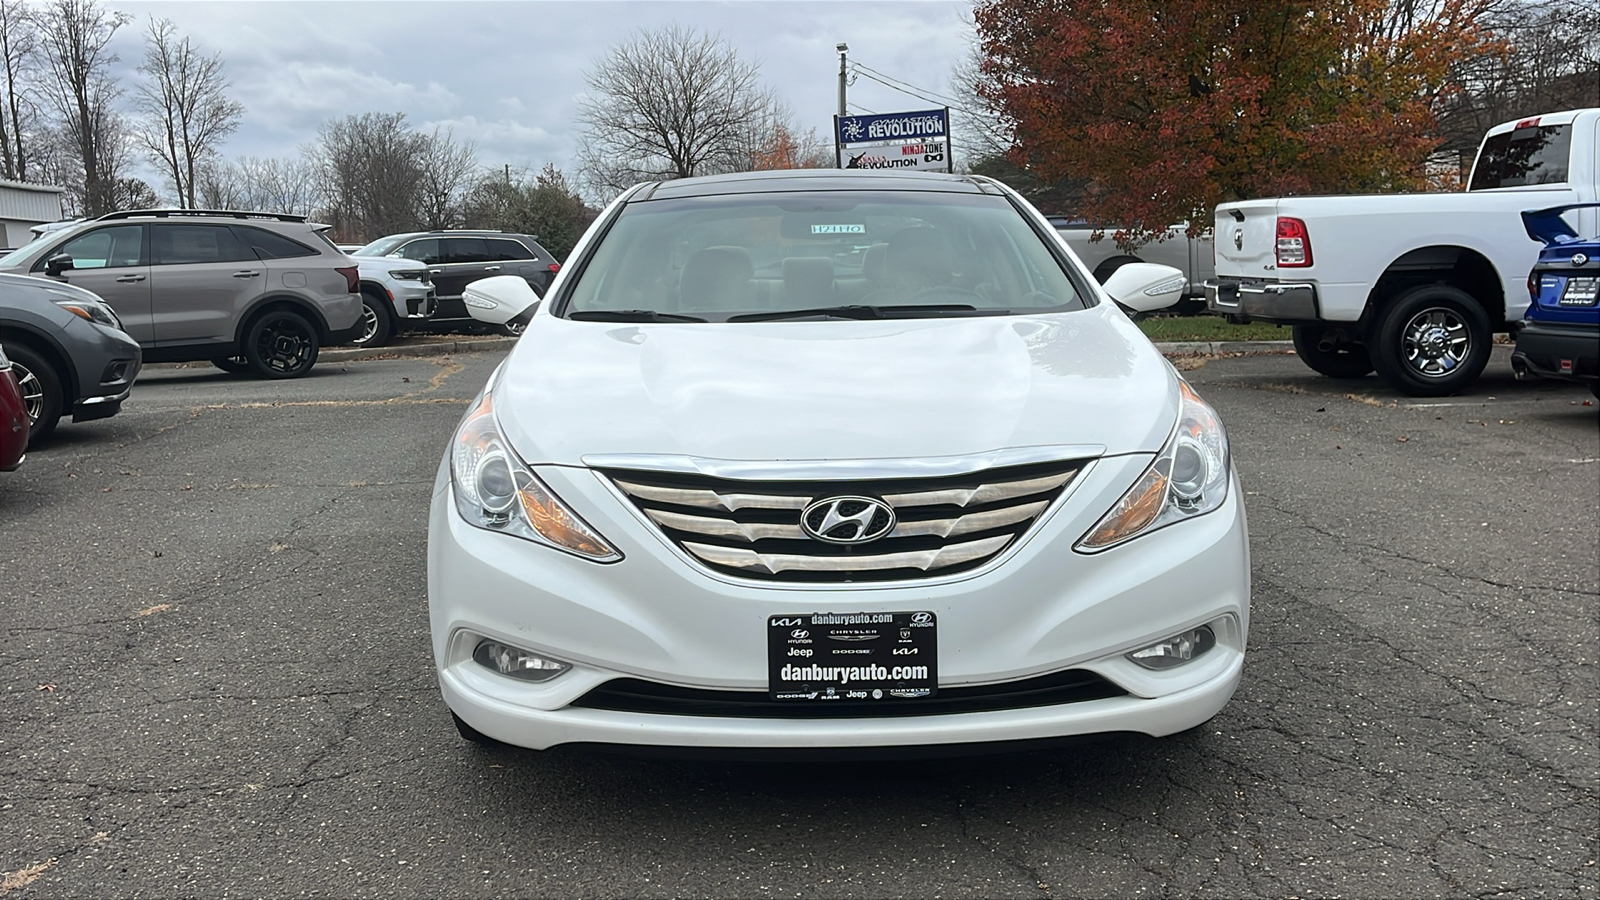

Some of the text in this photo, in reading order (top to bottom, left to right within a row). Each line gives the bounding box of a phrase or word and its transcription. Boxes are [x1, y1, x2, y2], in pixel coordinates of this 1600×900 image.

[871, 116, 939, 126] GYMNASTICS
[868, 120, 943, 138] REVOLUTION
[858, 158, 917, 169] REVOLUTION
[772, 618, 802, 627] KIA
[811, 613, 893, 625] danburyauto.com
[787, 647, 813, 658] Jeep
[892, 647, 918, 656] KIA
[781, 663, 928, 684] danburyauto.com
[846, 690, 867, 699] Jeep
